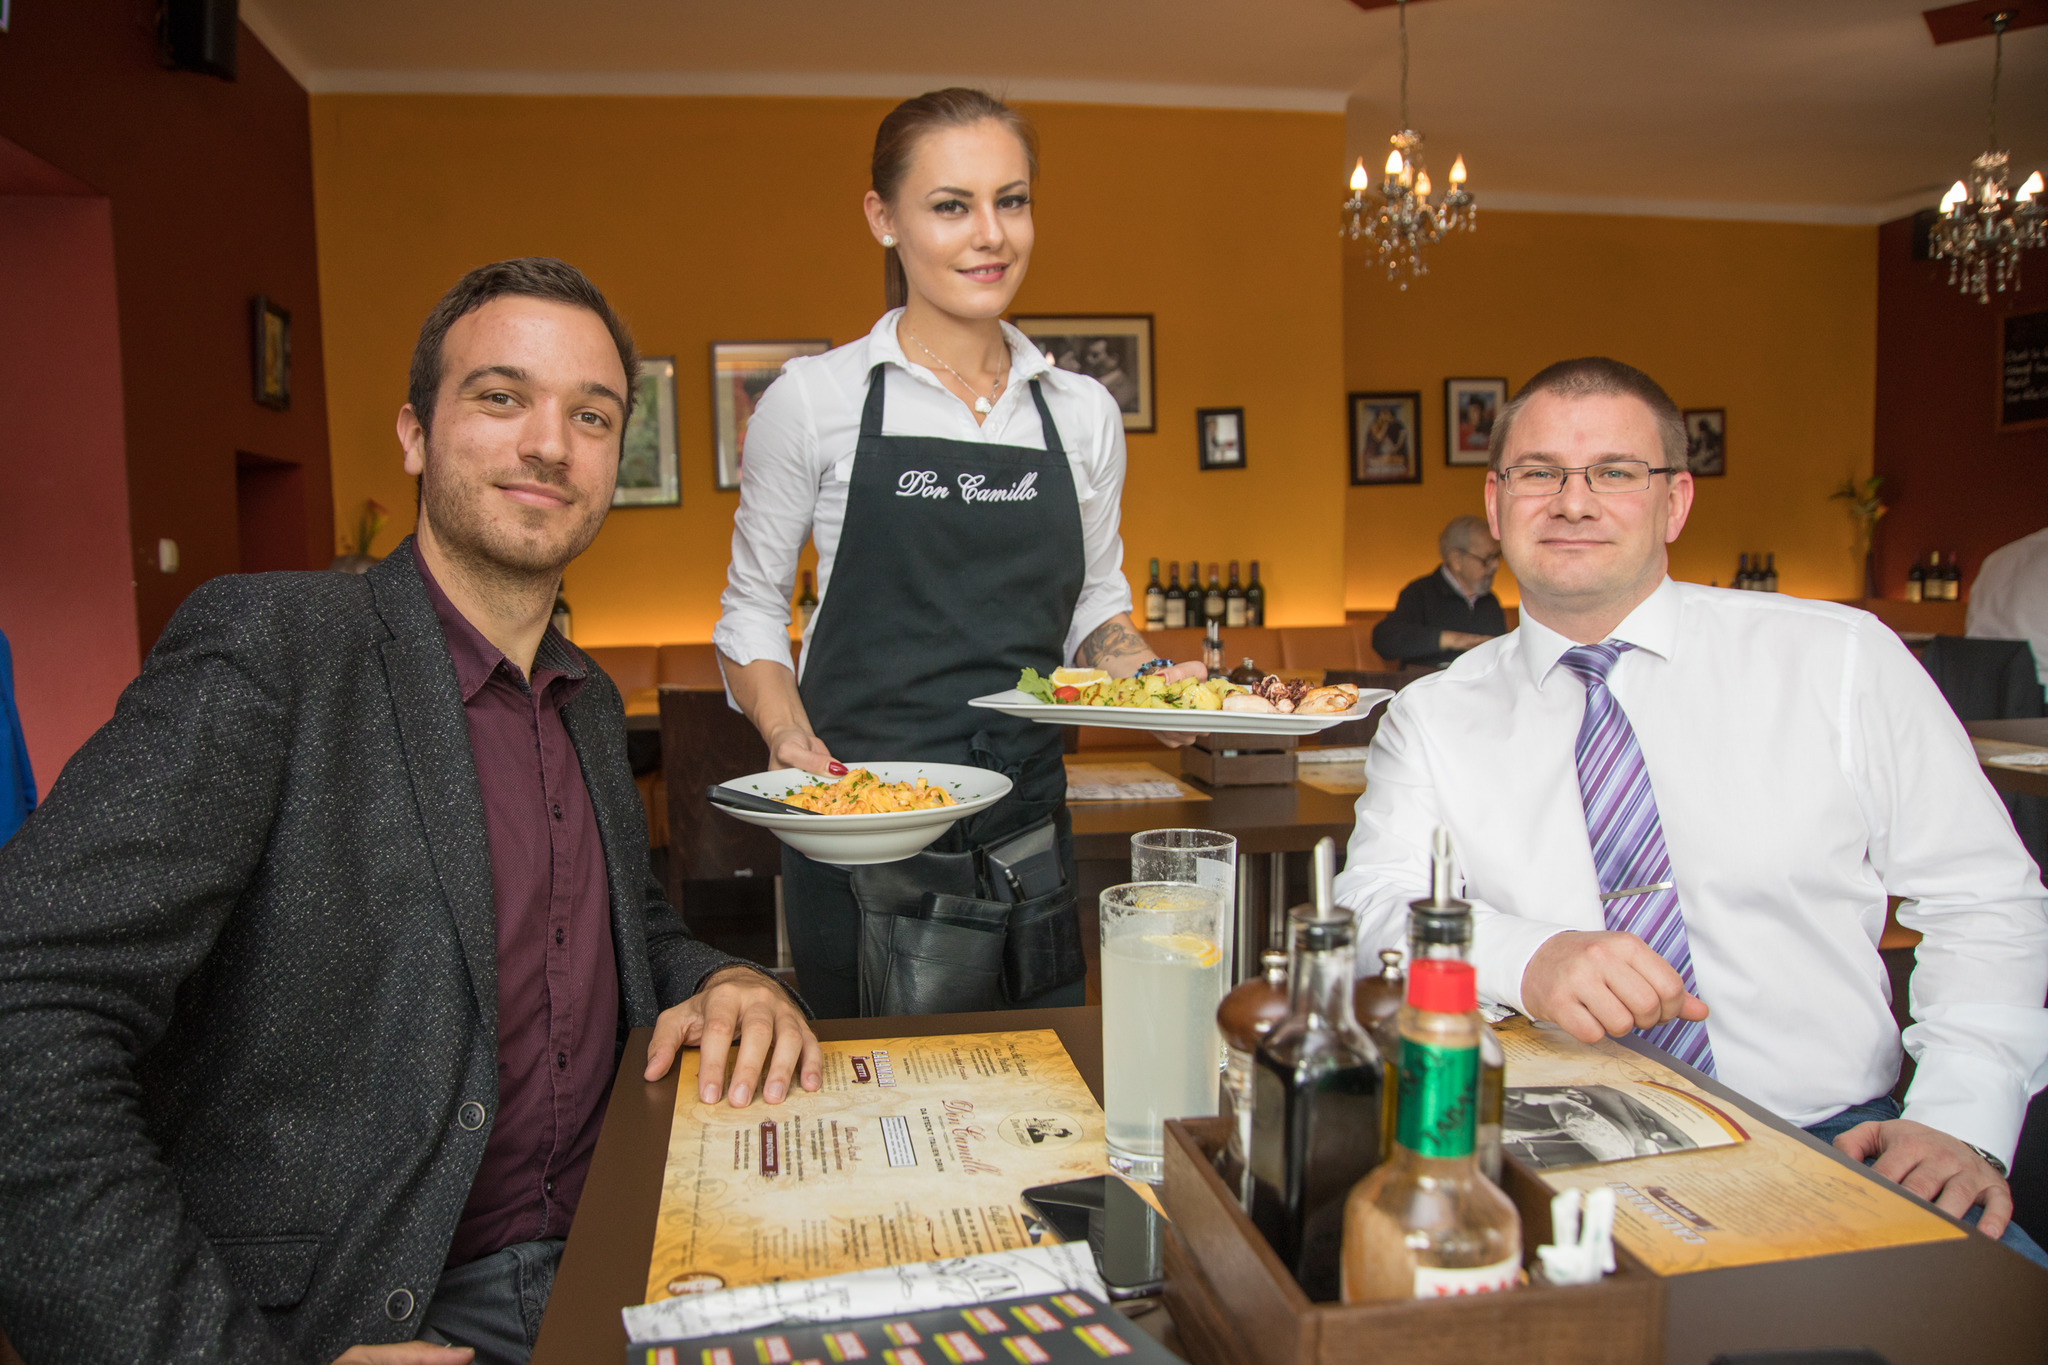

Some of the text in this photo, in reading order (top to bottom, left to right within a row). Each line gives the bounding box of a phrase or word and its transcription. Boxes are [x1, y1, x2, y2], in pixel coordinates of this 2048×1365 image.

[895, 470, 1038, 505] Don Camillo
[870, 1050, 898, 1088] CALAMARI
[941, 1099, 976, 1125] Don
[920, 1107, 945, 1173] DA STECKT ITALIEN DRIN
[951, 1125, 1004, 1177] Camillo
[1604, 1182, 1707, 1244] CALAMARI
